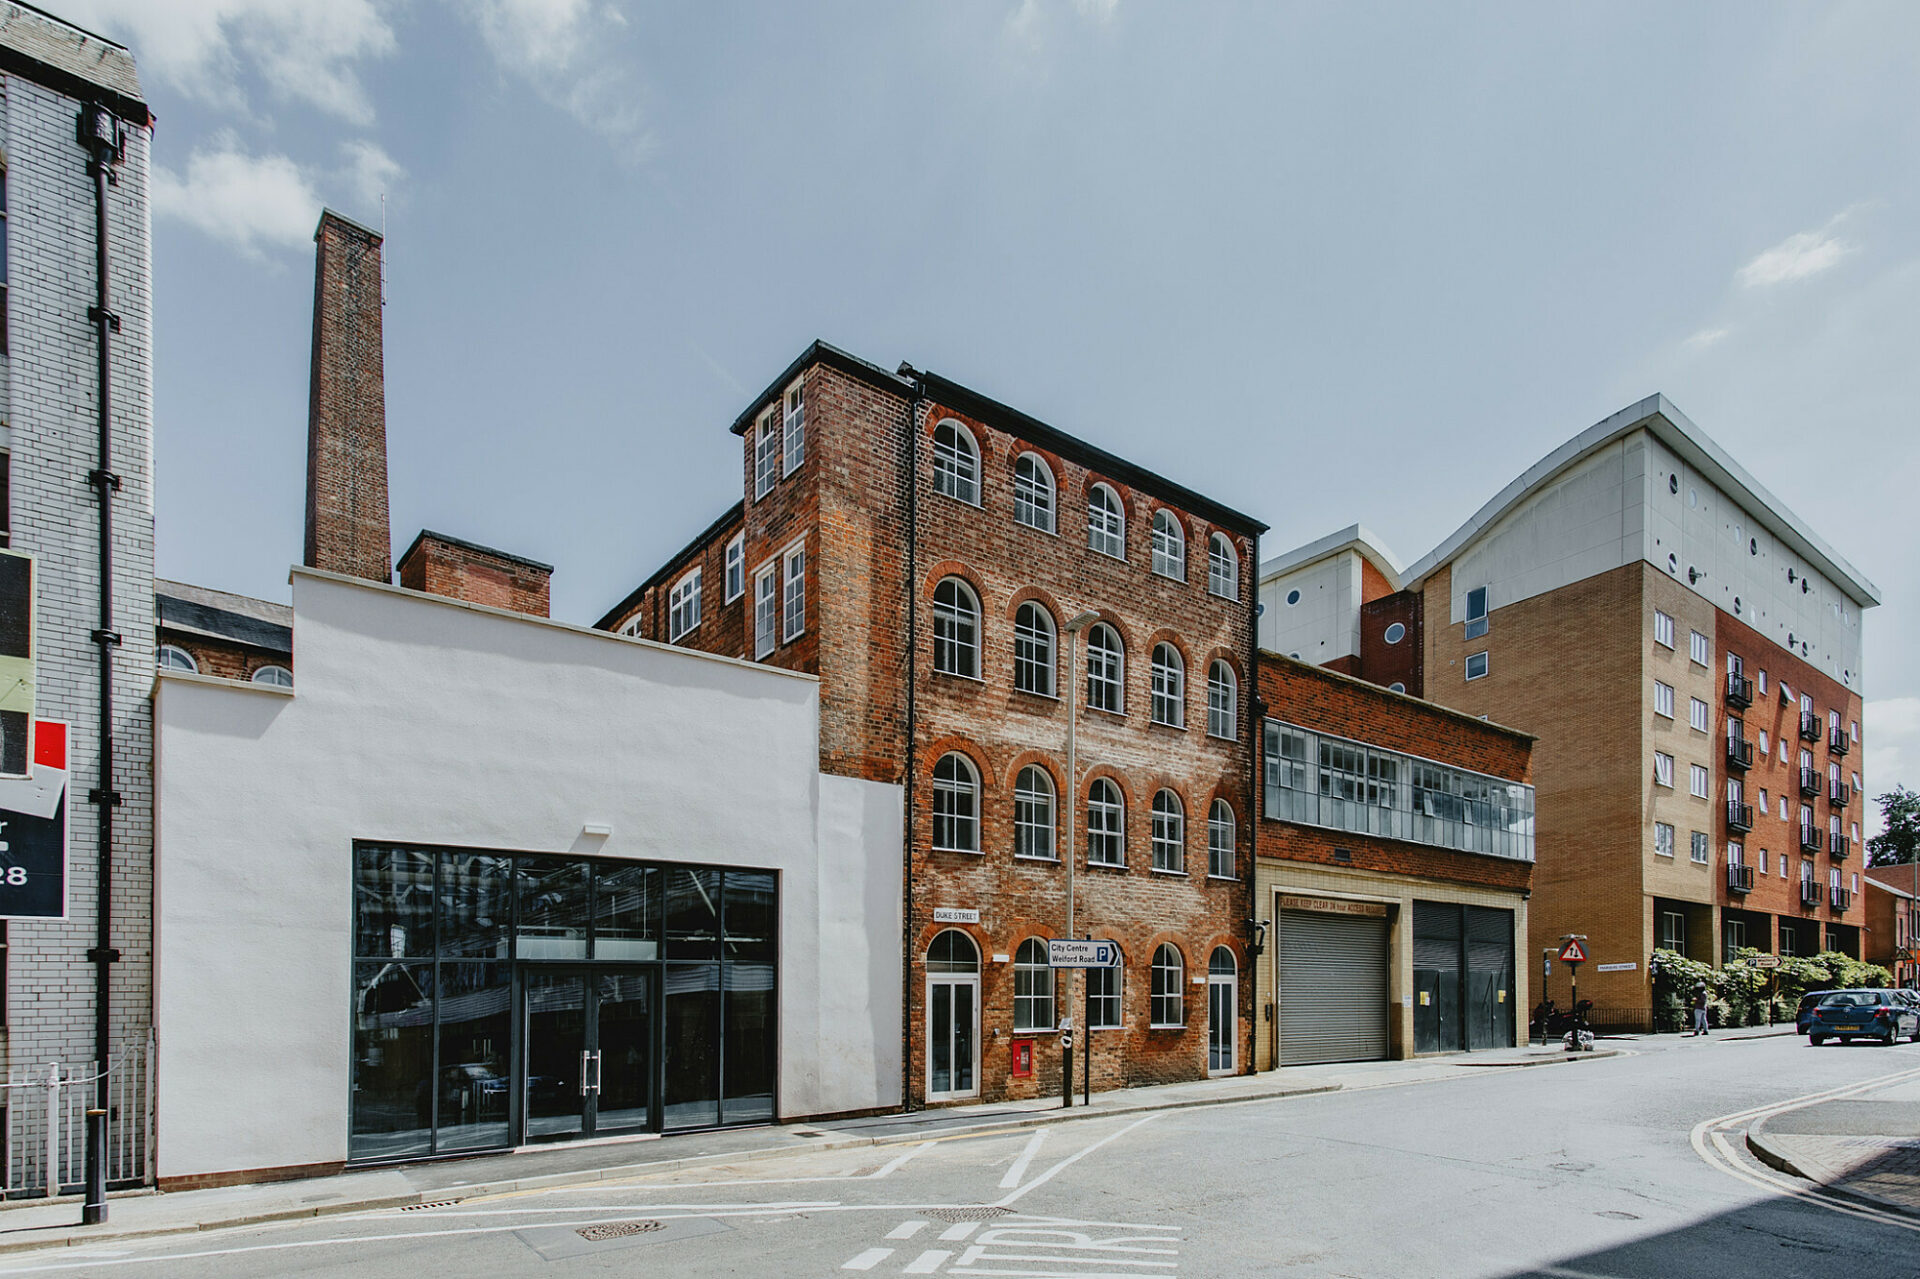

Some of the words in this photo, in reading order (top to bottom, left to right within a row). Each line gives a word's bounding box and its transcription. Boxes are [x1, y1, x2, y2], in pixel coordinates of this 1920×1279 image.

[1313, 900, 1328, 910] CLEAR
[935, 911, 952, 919] DUKE
[954, 912, 977, 920] STREET
[1051, 944, 1065, 953] City
[1066, 944, 1089, 952] Centre
[1052, 955, 1078, 963] Welford
[1079, 955, 1095, 963] Road
